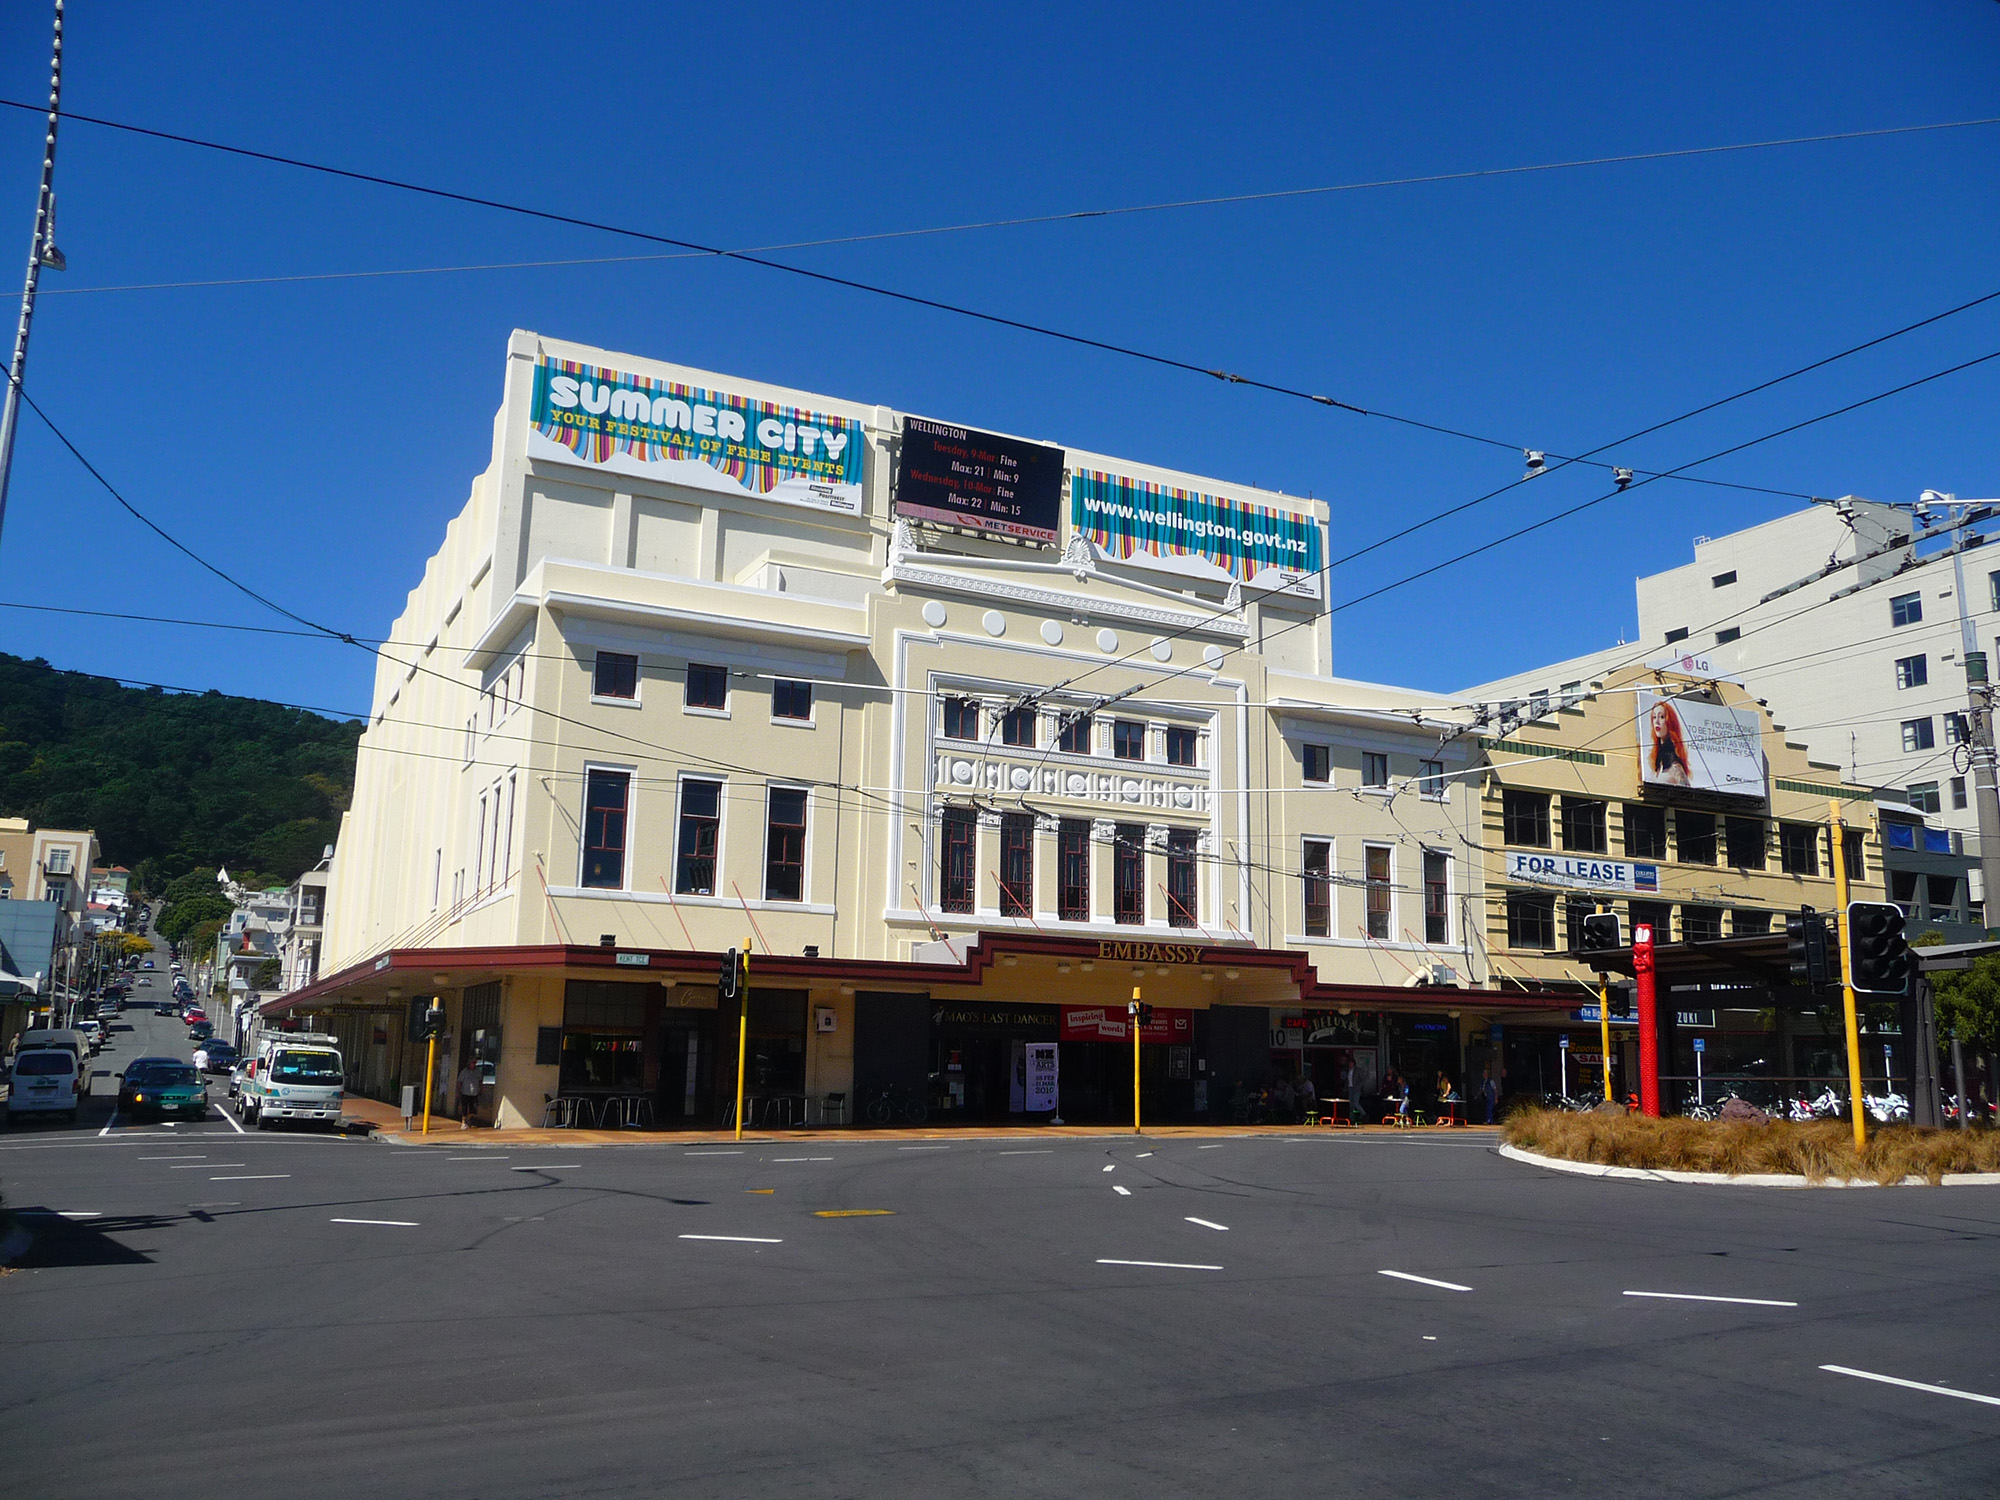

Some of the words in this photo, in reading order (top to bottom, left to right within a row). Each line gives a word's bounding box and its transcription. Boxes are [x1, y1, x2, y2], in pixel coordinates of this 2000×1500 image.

[550, 376, 745, 442] SUMMER
[757, 418, 847, 460] CITY
[909, 419, 967, 441] WELLINGTON
[551, 410, 600, 428] YOUR
[606, 420, 695, 447] FESTIVAL
[700, 439, 721, 452] OF
[726, 445, 771, 463] FREE
[778, 455, 845, 476] EVENTS
[933, 440, 969, 458] Tuesday,
[1000, 454, 1018, 467] Fine
[951, 461, 973, 475] Max:
[974, 465, 984, 477] 21
[993, 469, 1012, 482] Min:
[1013, 473, 1019, 483] 9
[910, 469, 960, 489] Wednesday,
[997, 486, 1015, 499] Fine
[948, 493, 969, 506] Max:
[971, 498, 982, 509] 22
[990, 501, 1009, 514] Min:
[1011, 505, 1021, 516] 15
[984, 520, 1054, 540] METSERVICE
[1084, 497, 1307, 553] www.wellington.govt.nz
[1696, 660, 1709, 671] LG
[1688, 724, 1697, 733] TO
[1698, 726, 1707, 735] BE
[1707, 728, 1732, 738] TALKED
[1710, 720, 1734, 731] YOU'RE
[1734, 725, 1755, 734] GOING
[1706, 745, 1726, 754] WHAT
[1727, 747, 1744, 757] THEY
[1729, 740, 1738, 748] AS
[1738, 741, 1755, 750] WELL
[1517, 855, 1555, 873] FOR
[1566, 860, 1626, 881] LEASE
[1098, 940, 1204, 964] EMBASSY
[944, 1011, 980, 1023] MAO'S
[982, 1012, 1009, 1024] LAST
[1013, 1012, 1057, 1025] DANCER
[1070, 1011, 1104, 1022] inspiring
[1287, 1017, 1308, 1029] CAFE
[1101, 1024, 1123, 1033] words
[1270, 1029, 1286, 1046] 10
[1035, 1049, 1054, 1059] NZ
